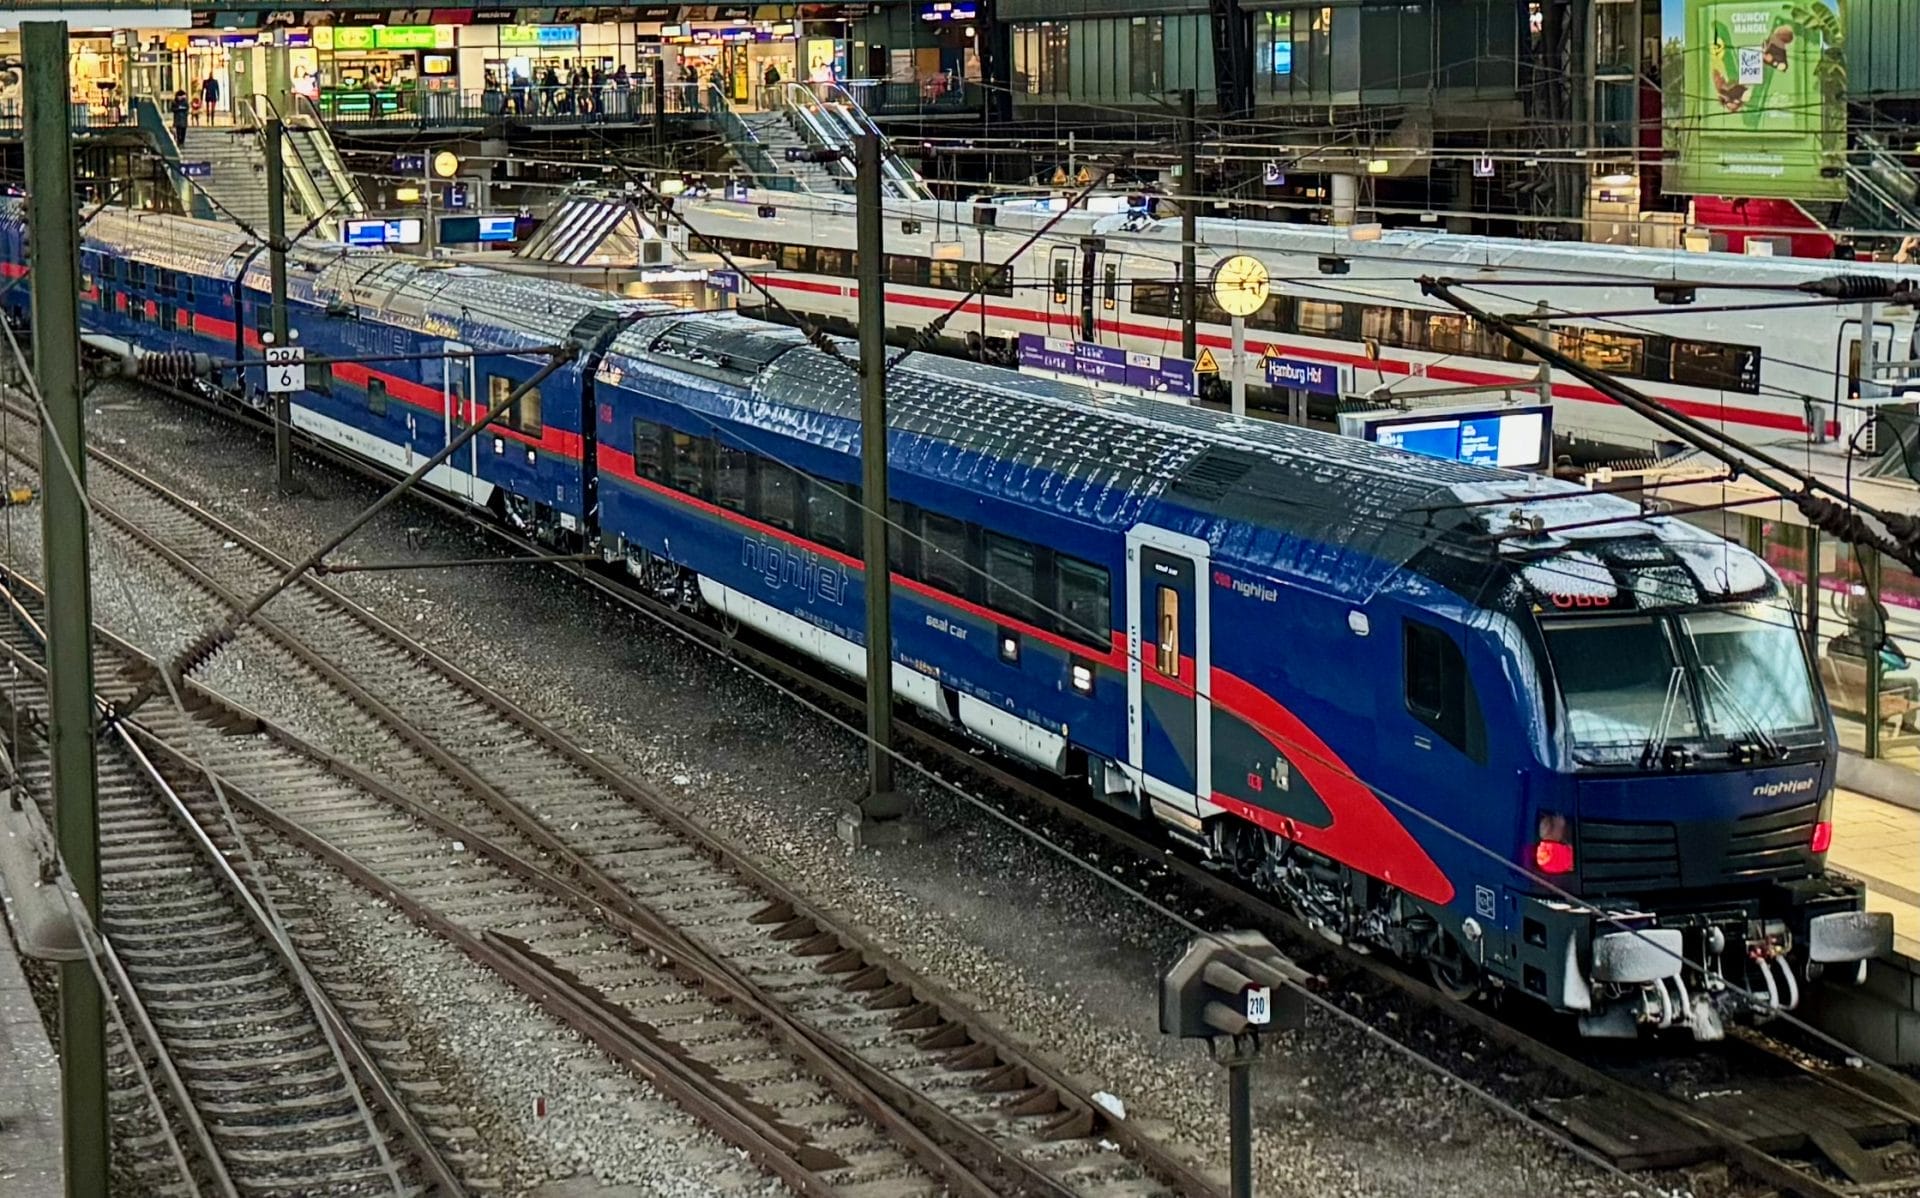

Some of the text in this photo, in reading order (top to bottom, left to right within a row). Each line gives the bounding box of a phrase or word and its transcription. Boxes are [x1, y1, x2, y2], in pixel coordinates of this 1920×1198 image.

[1267, 162, 1279, 181] D
[452, 188, 463, 206] E
[733, 181, 747, 200] E
[1744, 351, 1754, 370] 2
[280, 369, 292, 387] 6
[1269, 360, 1322, 384] Hamburg Hbf
[742, 533, 848, 606] nightjet
[1232, 579, 1278, 602] nightjet
[949, 624, 967, 640] car
[1752, 777, 1814, 797] nightjet
[1249, 996, 1265, 1015] 210
